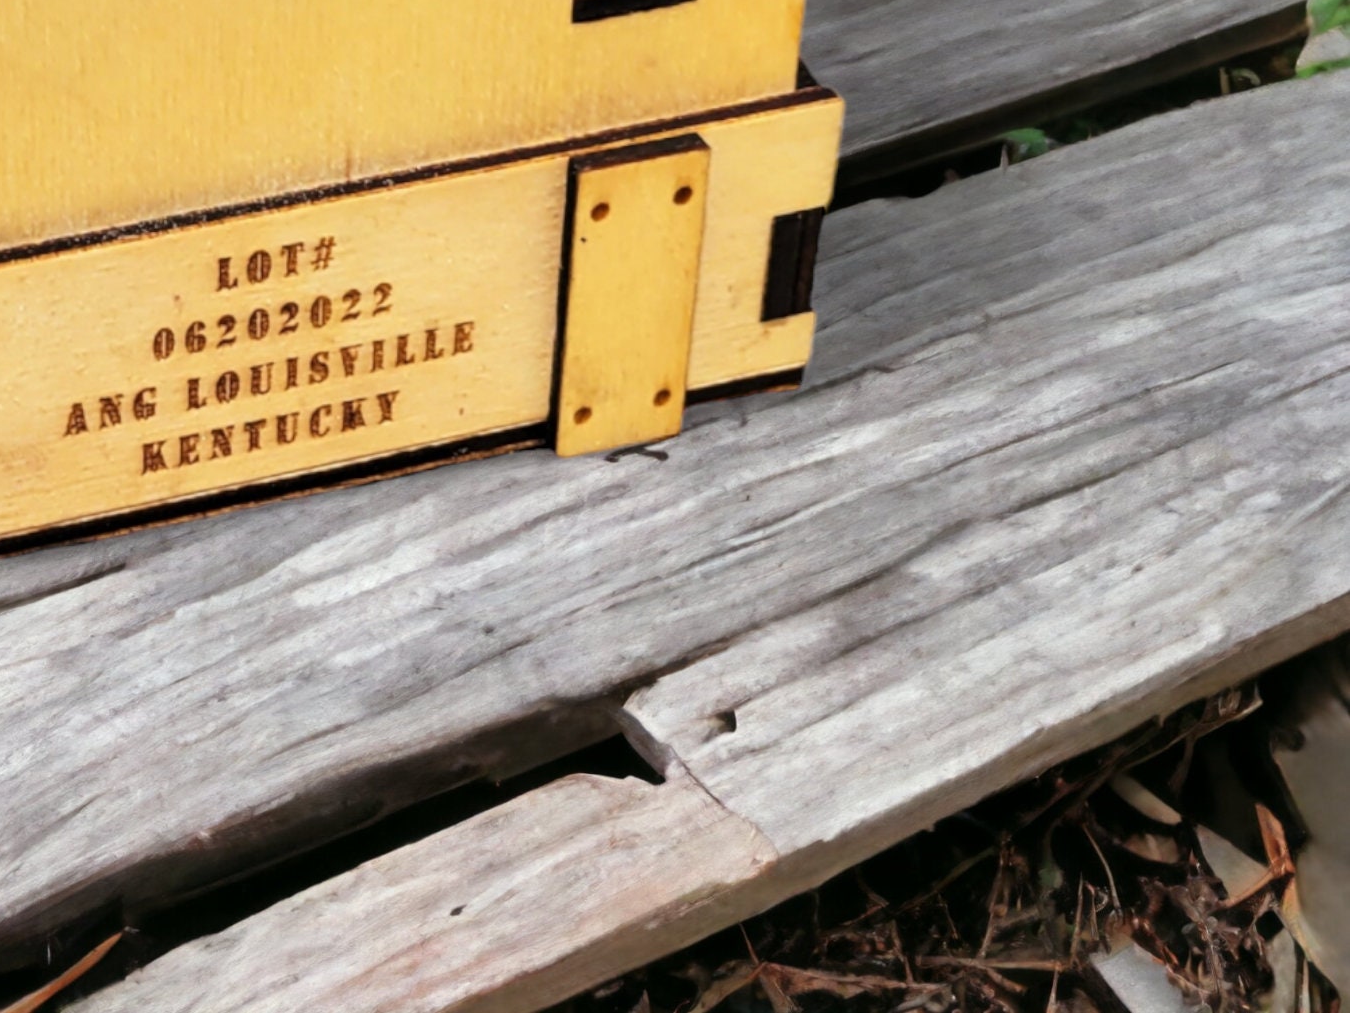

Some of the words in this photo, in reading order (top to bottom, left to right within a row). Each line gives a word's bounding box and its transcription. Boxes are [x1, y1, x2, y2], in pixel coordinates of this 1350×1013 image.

[216, 237, 336, 292] LOT#
[152, 283, 392, 361] 06202022
[63, 387, 156, 437] ANG
[186, 321, 474, 411] LOUISVILLE
[141, 391, 399, 475] KENTUCKY
